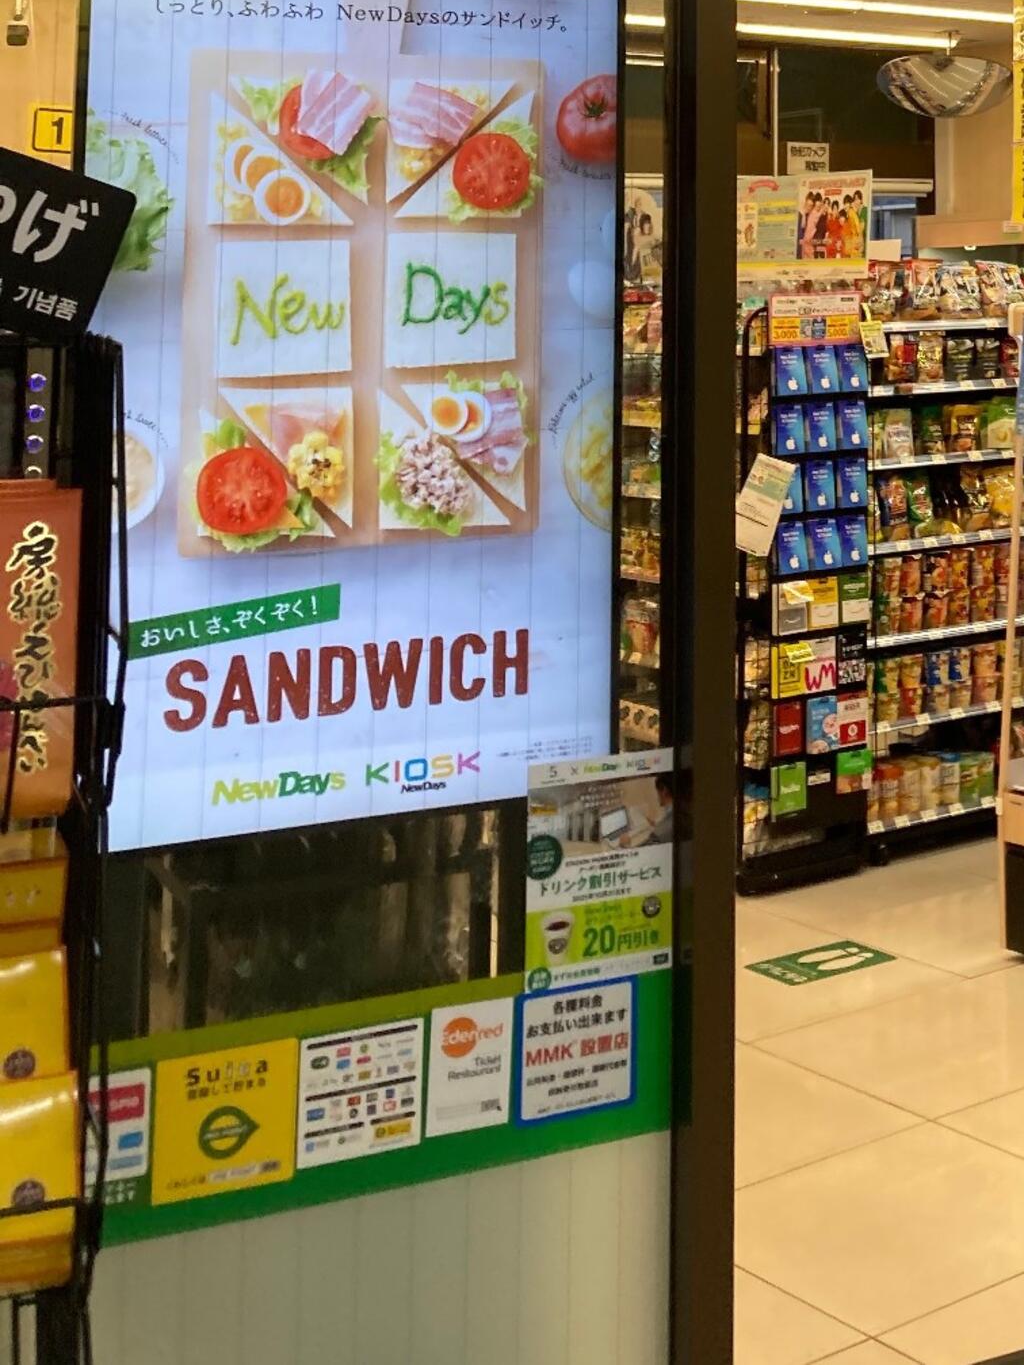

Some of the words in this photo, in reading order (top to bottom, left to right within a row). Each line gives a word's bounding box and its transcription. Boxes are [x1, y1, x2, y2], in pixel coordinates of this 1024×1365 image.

[336, 3, 569, 33] NewDaysのサンドイッチ。
[51, 117, 64, 145] 1
[14, 285, 79, 322] 기념품
[232, 270, 346, 345] New
[402, 262, 509, 335] Days
[163, 628, 530, 733] SANDWICH
[211, 767, 347, 807] NewDays
[365, 750, 482, 787] KIOSK
[525, 1007, 628, 1039] お支払い出来ます
[524, 1042, 573, 1068] MMK
